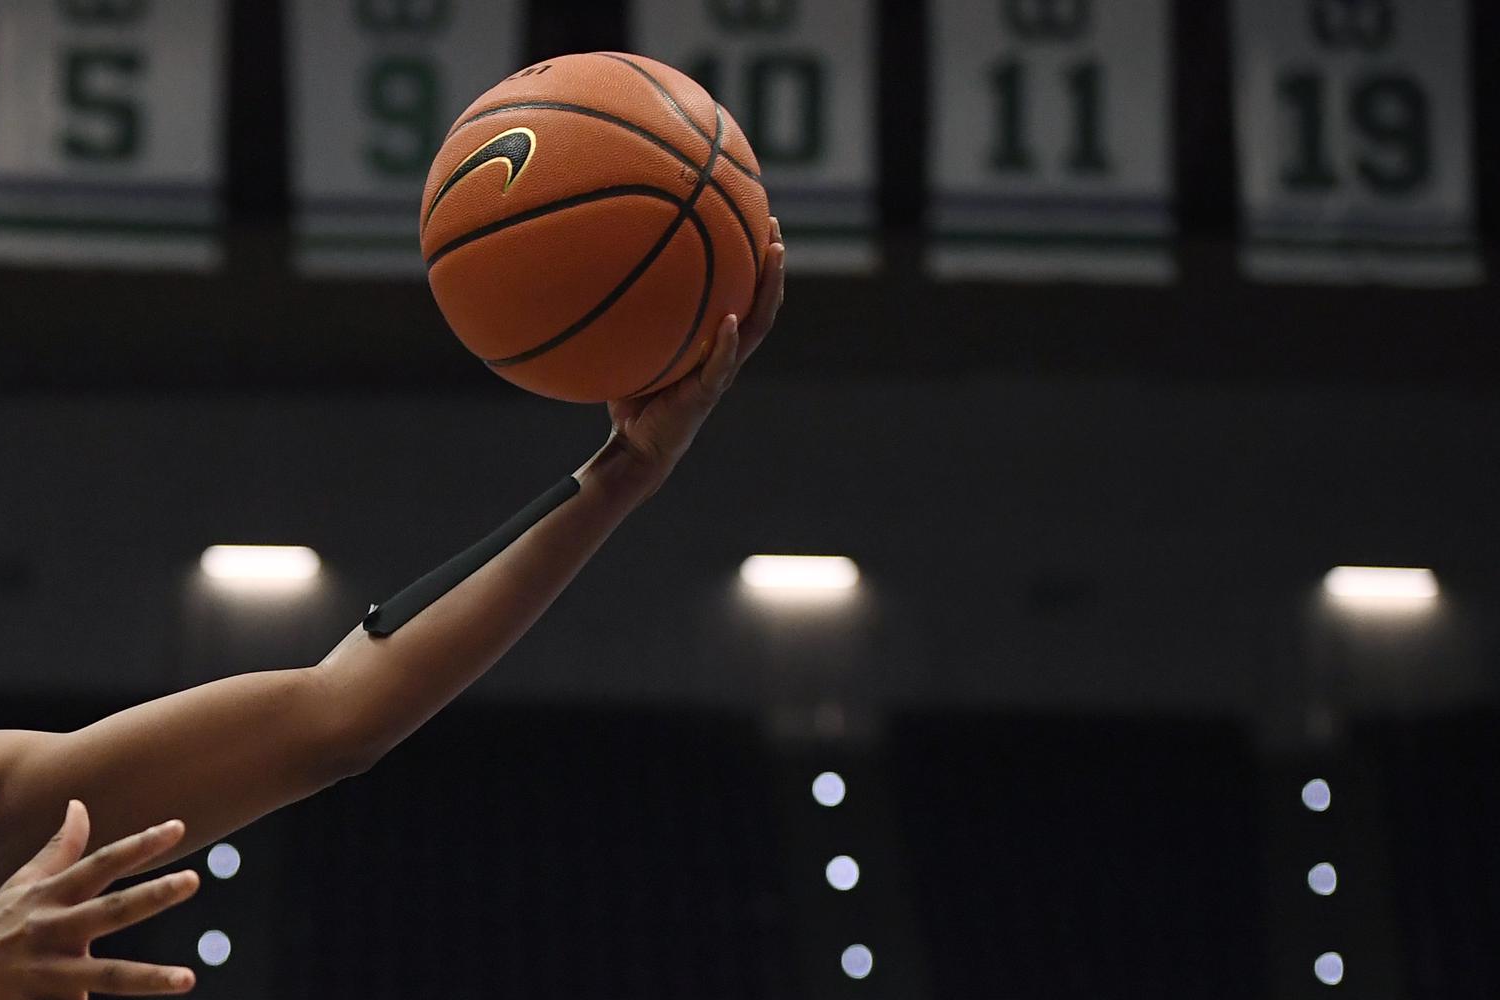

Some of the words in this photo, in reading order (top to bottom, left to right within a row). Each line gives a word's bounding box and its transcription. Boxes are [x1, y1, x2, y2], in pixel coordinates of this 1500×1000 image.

[59, 48, 148, 164] 5
[362, 54, 440, 176] 9
[984, 54, 1108, 174] 11
[1276, 70, 1430, 192] 19
